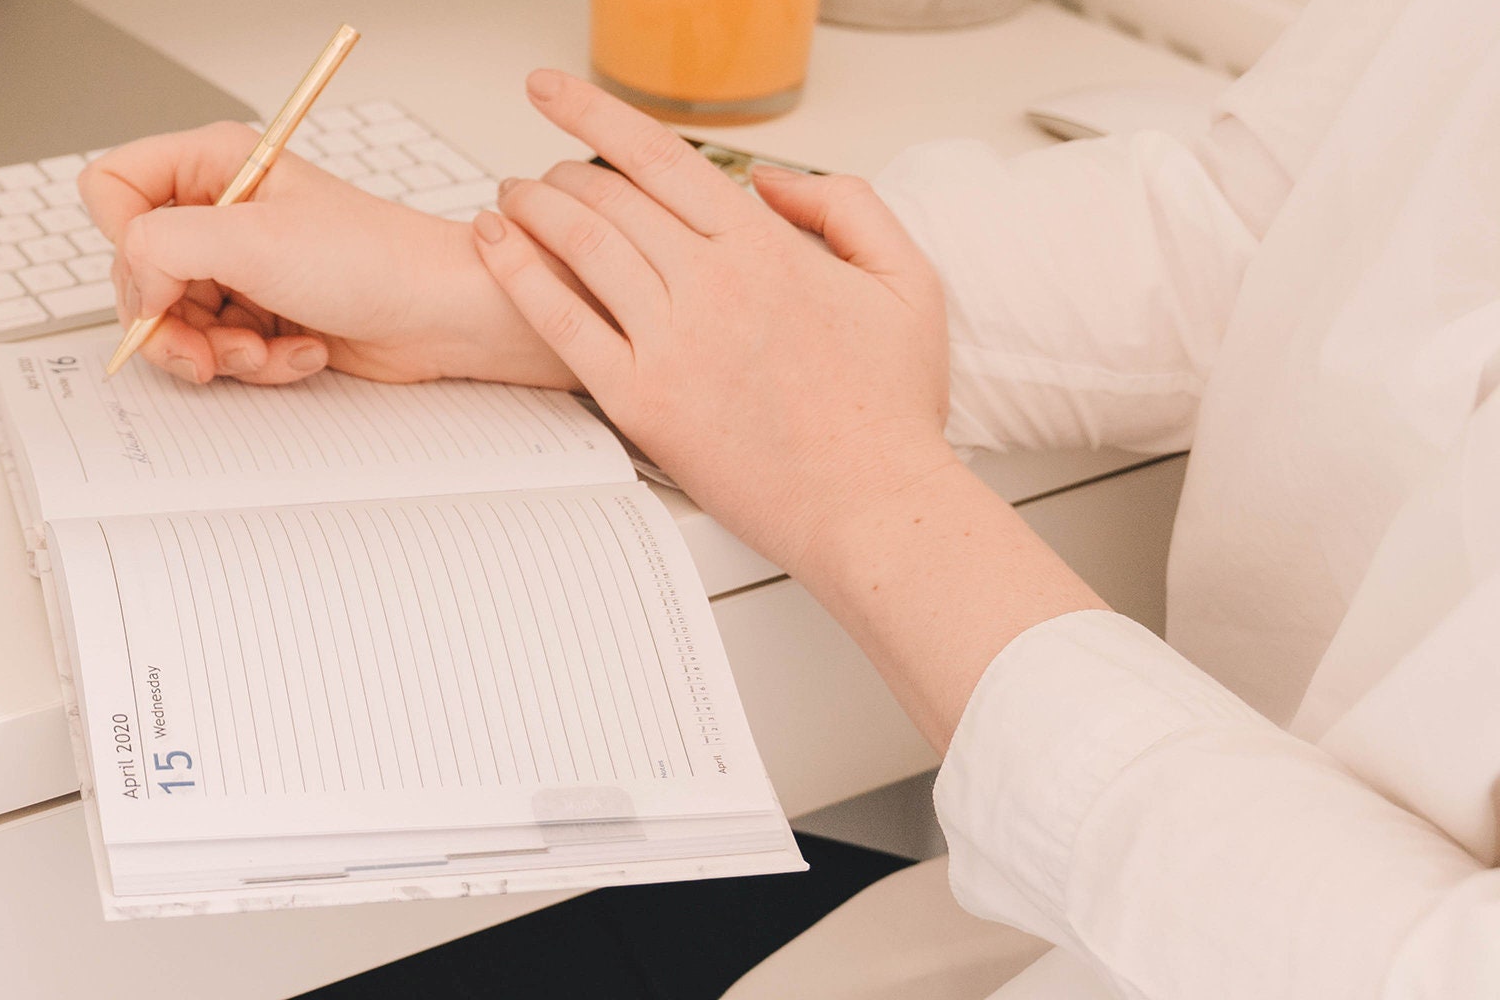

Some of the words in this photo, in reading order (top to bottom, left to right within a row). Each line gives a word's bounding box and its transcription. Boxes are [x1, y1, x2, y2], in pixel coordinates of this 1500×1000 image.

[48, 356, 79, 373] 16
[147, 665, 166, 739] Wednesday
[112, 714, 132, 752] 2020
[118, 760, 141, 800] April
[153, 750, 195, 794] 15
[658, 759, 668, 778] Notes
[713, 754, 727, 774] April
